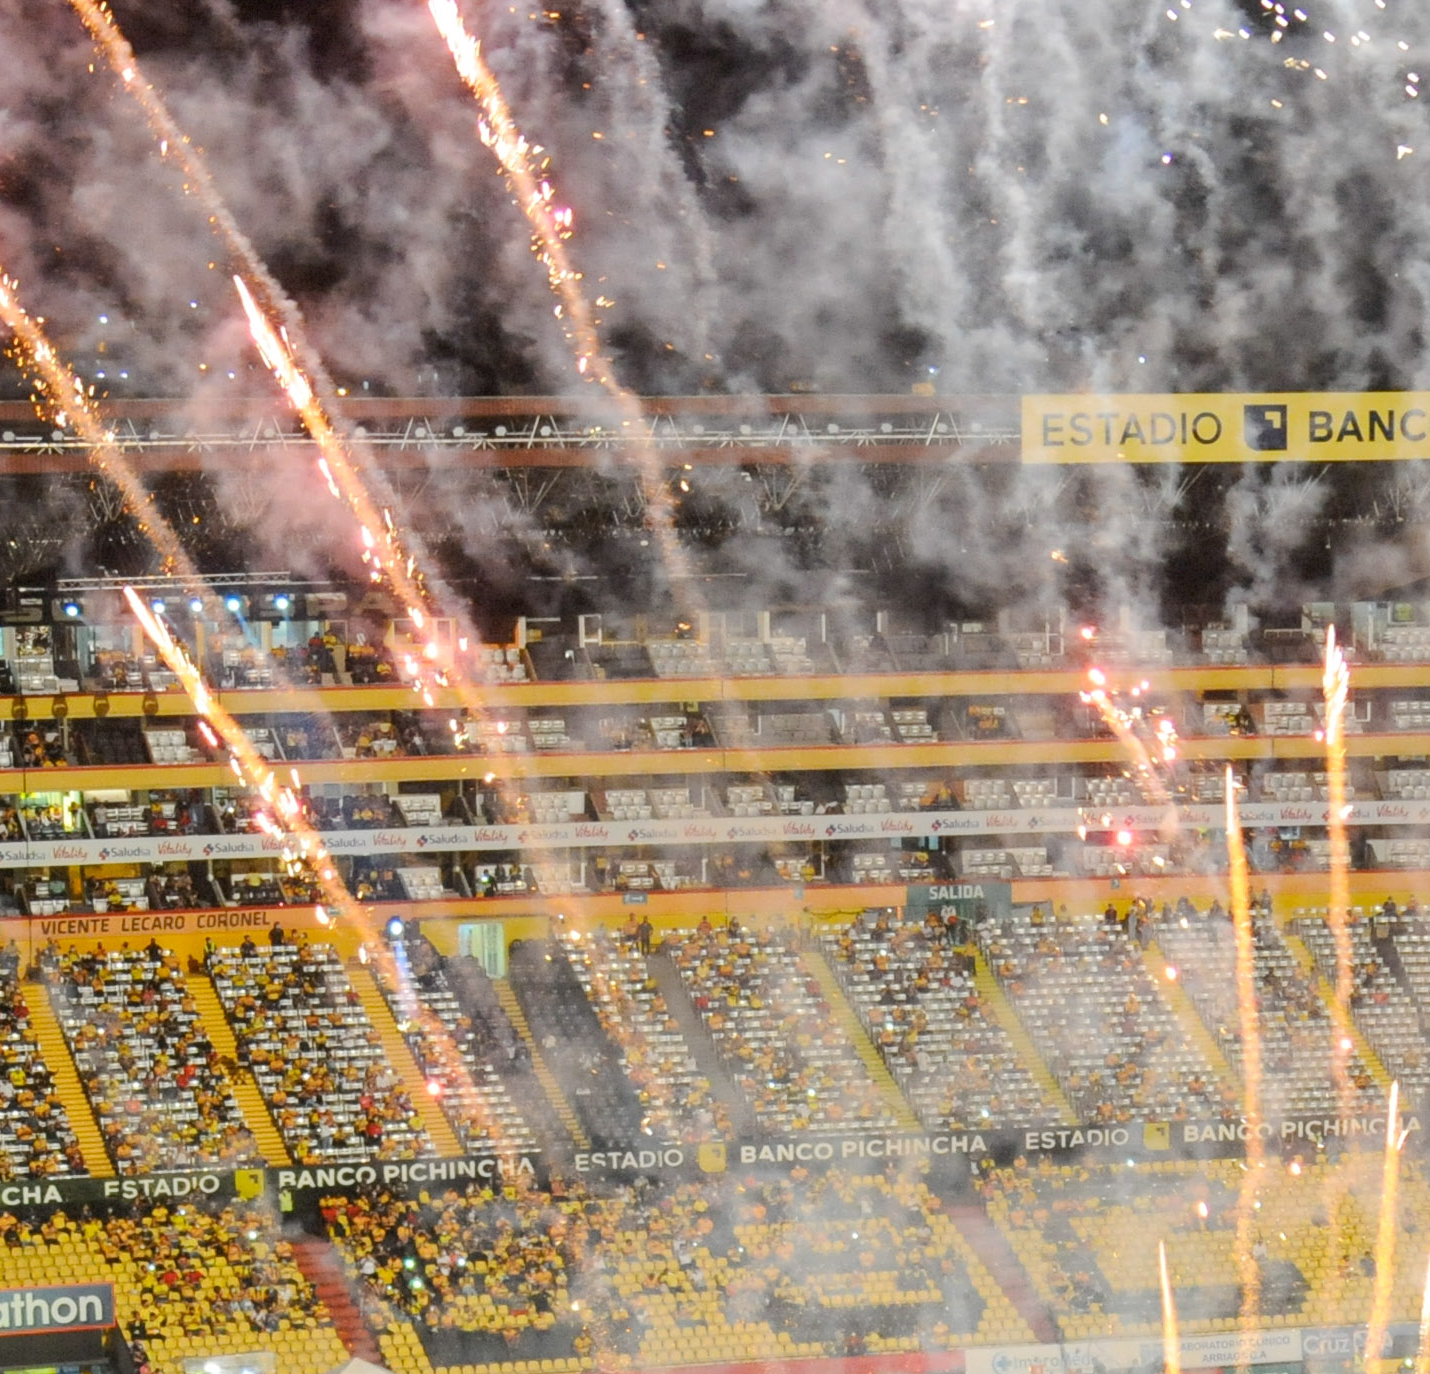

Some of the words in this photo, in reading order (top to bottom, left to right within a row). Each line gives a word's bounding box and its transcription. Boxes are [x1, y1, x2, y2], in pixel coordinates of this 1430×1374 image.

[1042, 411, 1222, 447] ESTADIO
[1280, 807, 1312, 822] Vitality
[1377, 805, 1409, 819] Vitality
[783, 820, 816, 836] Vitality
[837, 822, 874, 833] Saludsa
[881, 818, 914, 833] Vitality
[942, 819, 980, 828] Saludsa
[986, 813, 1019, 827] Vitality
[429, 833, 467, 843] Saludsa
[474, 828, 508, 843] Vitality
[575, 824, 609, 838] Vitality
[684, 822, 717, 837] Vitality
[215, 843, 254, 852] Saludsa
[373, 833, 407, 847] Vitality
[5, 850, 46, 861] Saludsa
[53, 846, 89, 861] Vitality
[111, 847, 151, 857] Saludsa
[157, 841, 193, 856] Vitality
[929, 884, 984, 900] SALIDA
[41, 918, 110, 935] VICENTE
[121, 915, 185, 932] LECARO
[197, 912, 270, 929] CORONEL
[1025, 1129, 1129, 1150] ESTADIO
[1184, 1123, 1274, 1143] BANCO
[1282, 1117, 1421, 1138] PICHINCA
[575, 1149, 684, 1172] ESTADIO
[741, 1142, 833, 1164] BANCO
[842, 1135, 987, 1158] PICHINCHA
[104, 1174, 219, 1199] ESTADIO
[278, 1171, 376, 1190] BANCO
[384, 1157, 535, 1184] PICHINCHA
[1175, 1338, 1245, 1351] ABORATORIO
[1303, 1336, 1350, 1355] Cruz
